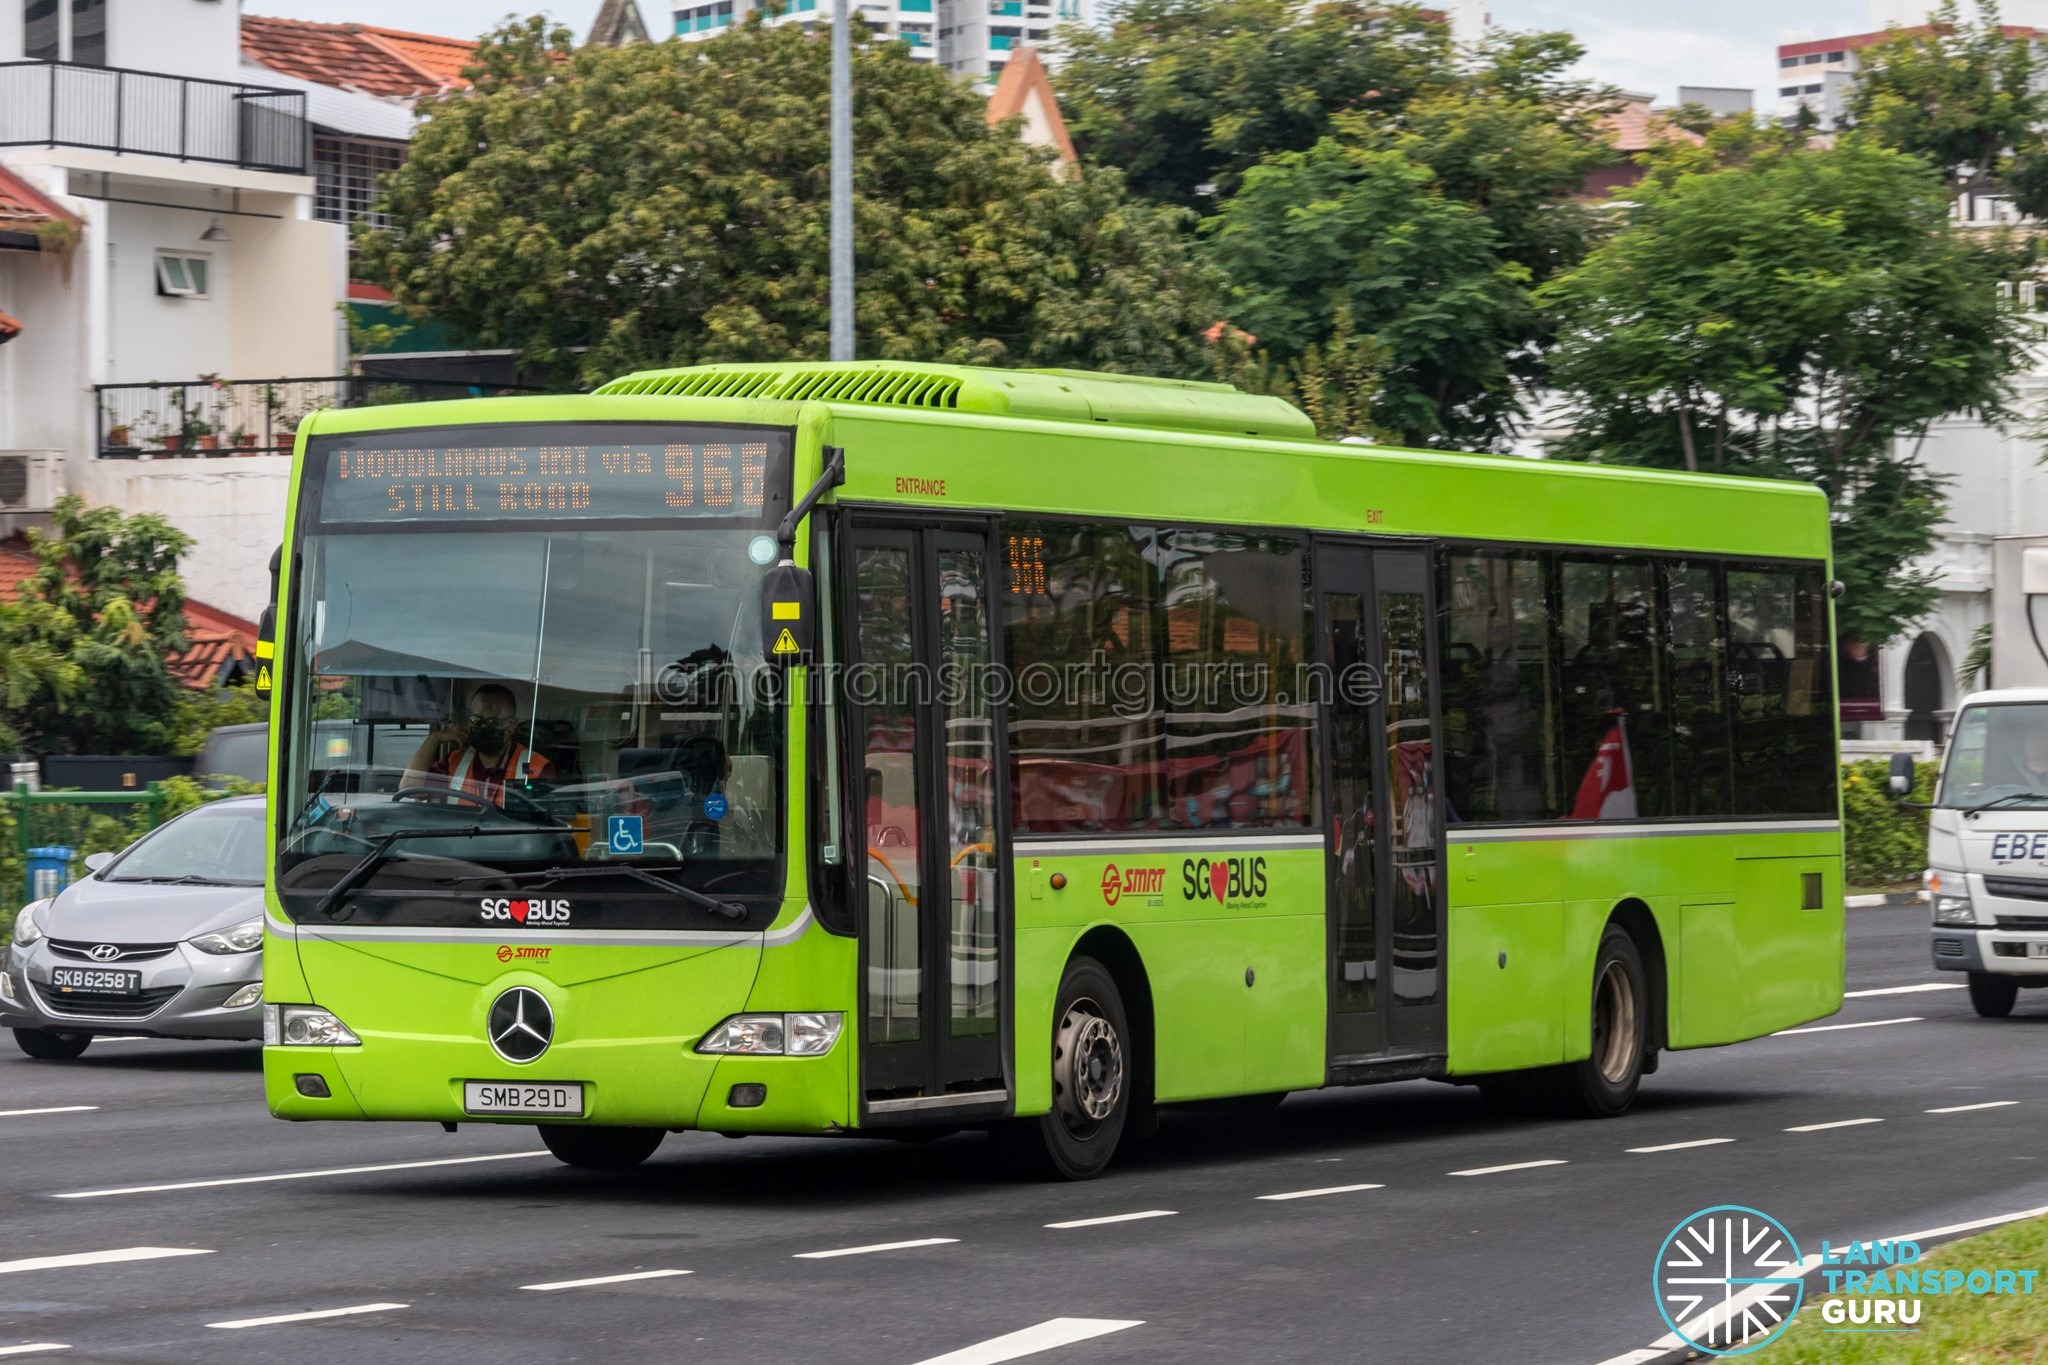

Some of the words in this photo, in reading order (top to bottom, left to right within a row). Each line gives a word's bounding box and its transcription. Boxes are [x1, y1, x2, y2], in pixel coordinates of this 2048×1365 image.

[341, 446, 526, 478] WOODLANDS
[541, 445, 587, 475] INT
[602, 444, 651, 474] via
[664, 442, 767, 507] 966
[387, 484, 480, 512] STILL
[500, 482, 590, 510] ROAD
[895, 477, 946, 496] ENTRANCE
[1366, 508, 1383, 525] EXIT
[1009, 536, 1045, 594] 966
[1122, 868, 1166, 893] SMRT
[515, 947, 552, 959] SMRT
